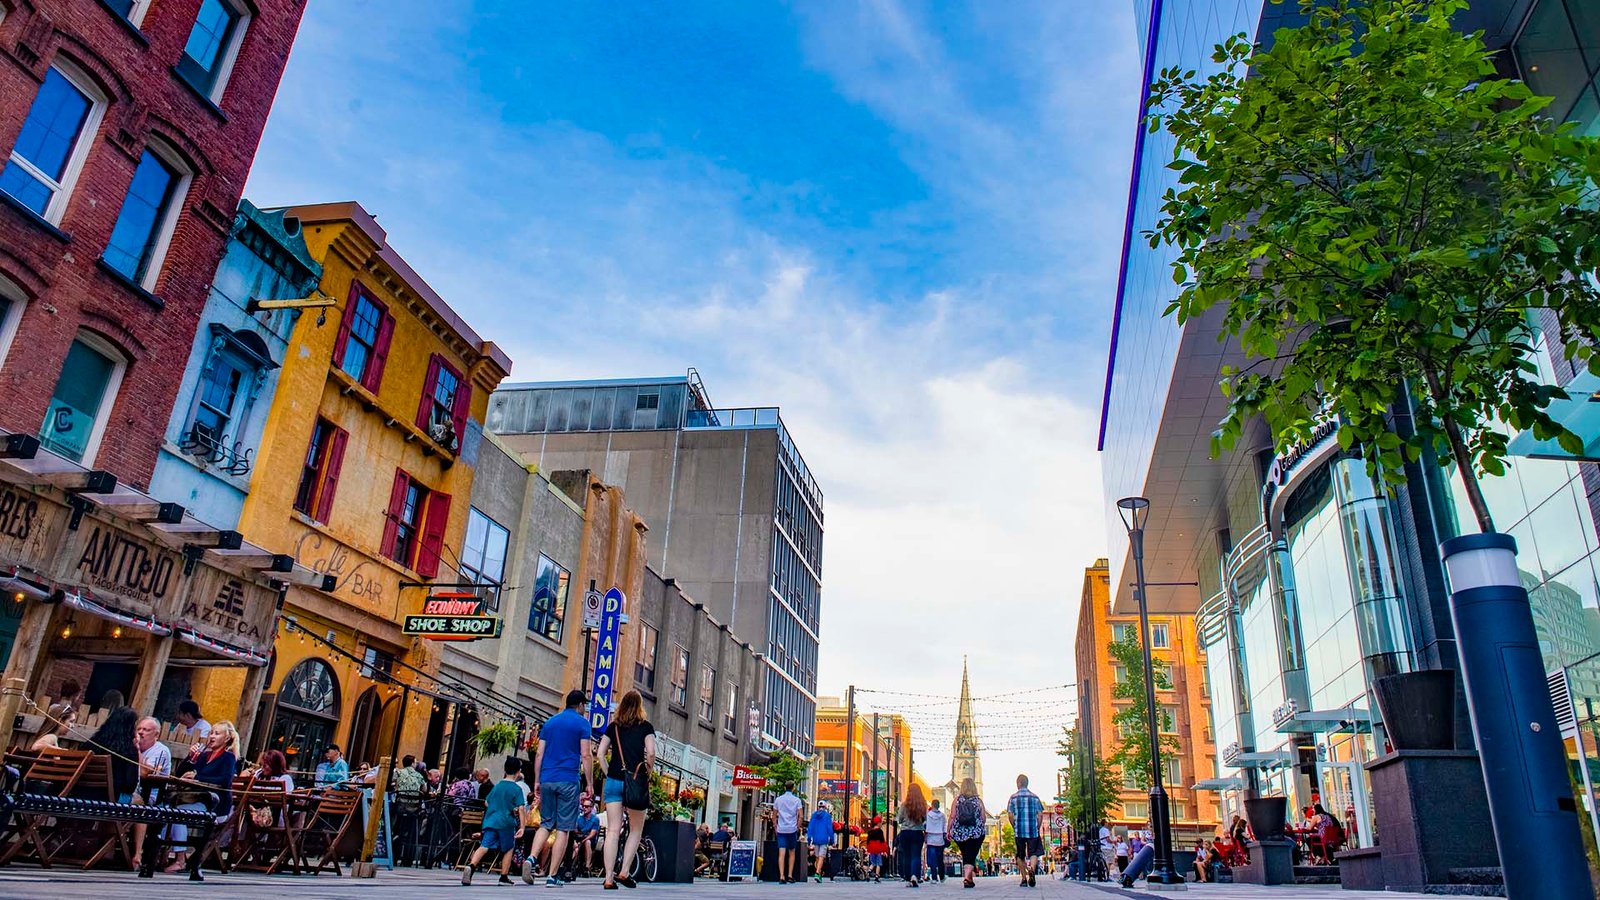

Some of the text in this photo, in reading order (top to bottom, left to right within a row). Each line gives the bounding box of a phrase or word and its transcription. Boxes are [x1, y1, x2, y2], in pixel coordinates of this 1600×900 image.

[351, 575, 384, 604] BAR
[184, 602, 260, 639] AZTECA
[425, 600, 481, 615] ECONOMY
[409, 618, 492, 633] SHOE SHOP
[592, 597, 618, 729] DIAMOND
